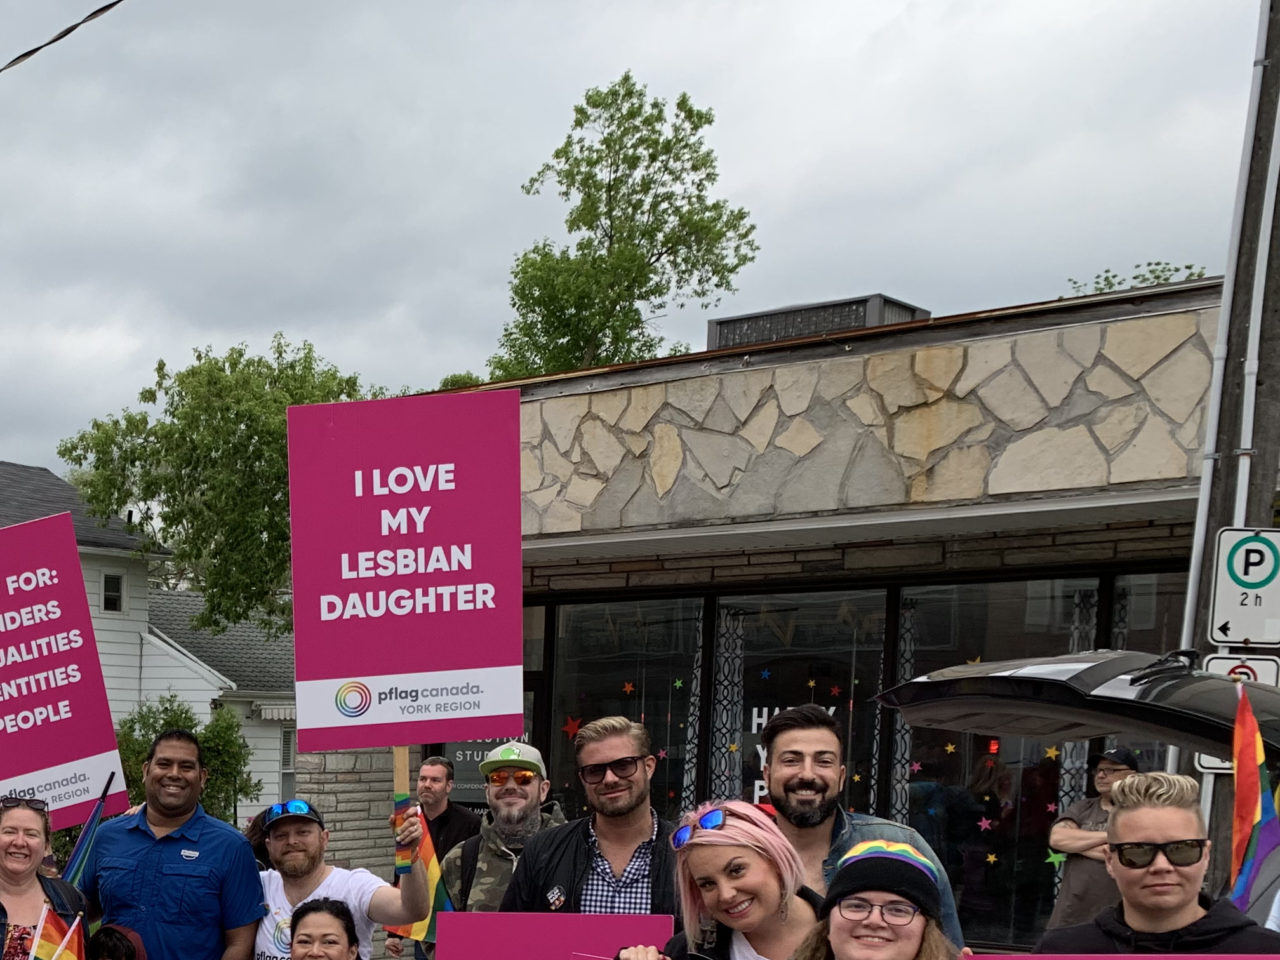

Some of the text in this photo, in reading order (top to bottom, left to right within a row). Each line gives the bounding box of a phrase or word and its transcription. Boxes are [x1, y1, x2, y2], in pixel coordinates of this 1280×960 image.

[355, 464, 455, 496] I LOVE
[381, 507, 431, 535] MY
[342, 544, 471, 579] LESBIAN
[1243, 548, 1266, 576] P
[6, 568, 58, 594] FOR:
[321, 583, 495, 620] DAUGHTER
[1240, 592, 1262, 607] 2 h
[400, 701, 481, 715] YORK REGION
[51, 786, 90, 803] REGION
